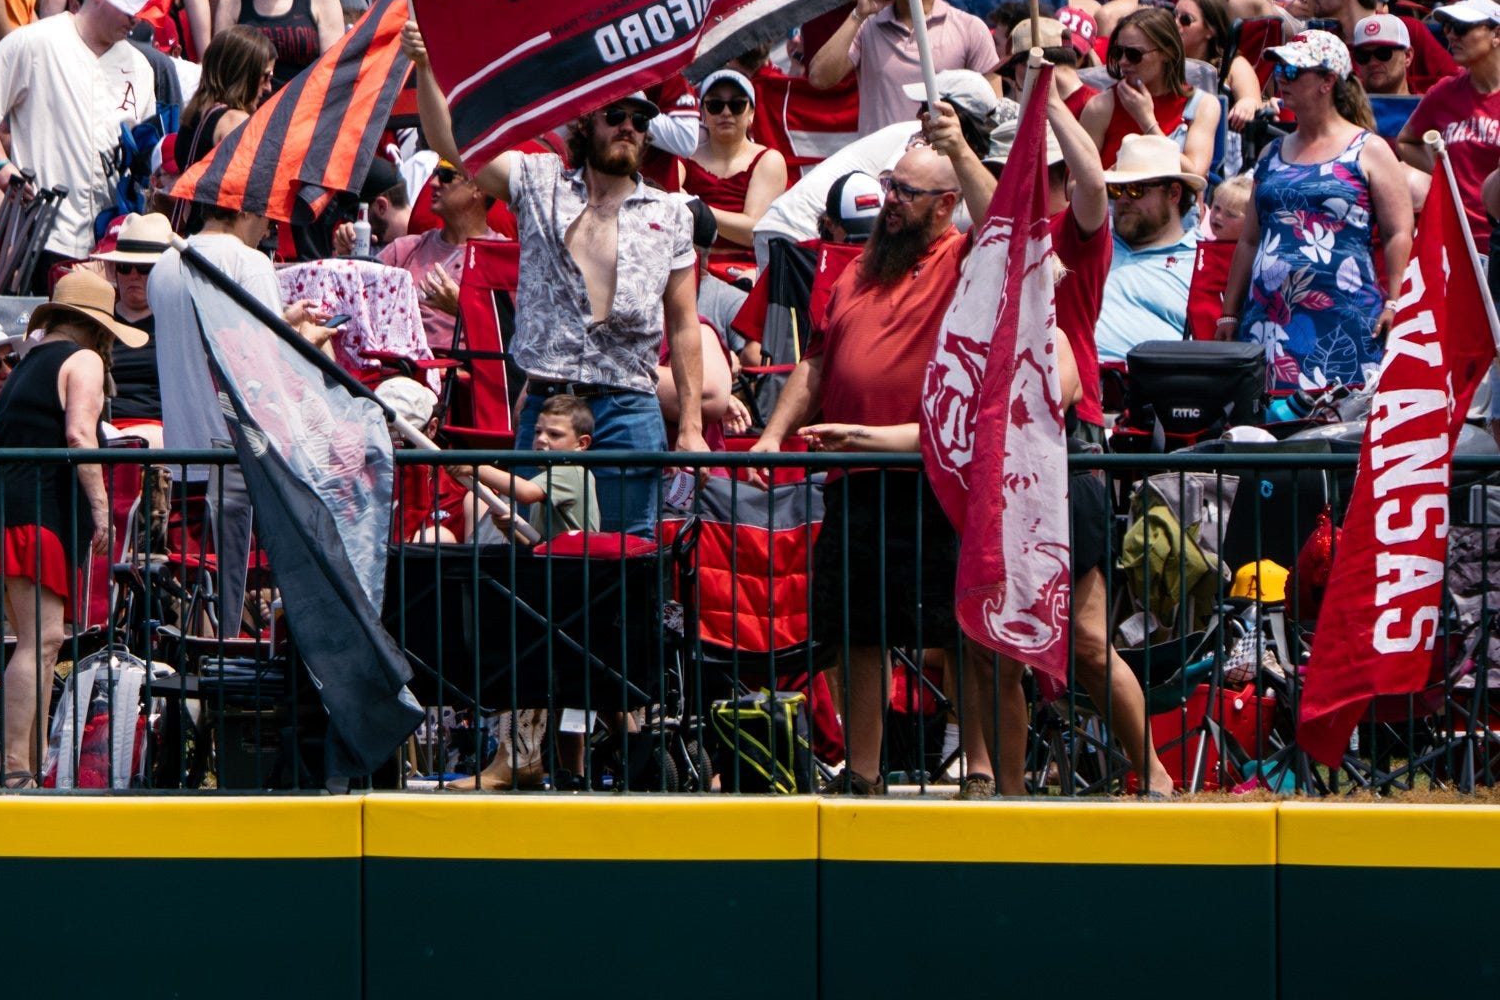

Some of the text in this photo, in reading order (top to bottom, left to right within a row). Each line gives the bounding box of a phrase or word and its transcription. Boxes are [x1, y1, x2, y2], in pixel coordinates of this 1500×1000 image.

[1058, 11, 1094, 40] PIG
[116, 80, 138, 121] A
[1172, 407, 1201, 418] RTIC
[1370, 254, 1450, 656] RKANSAS
